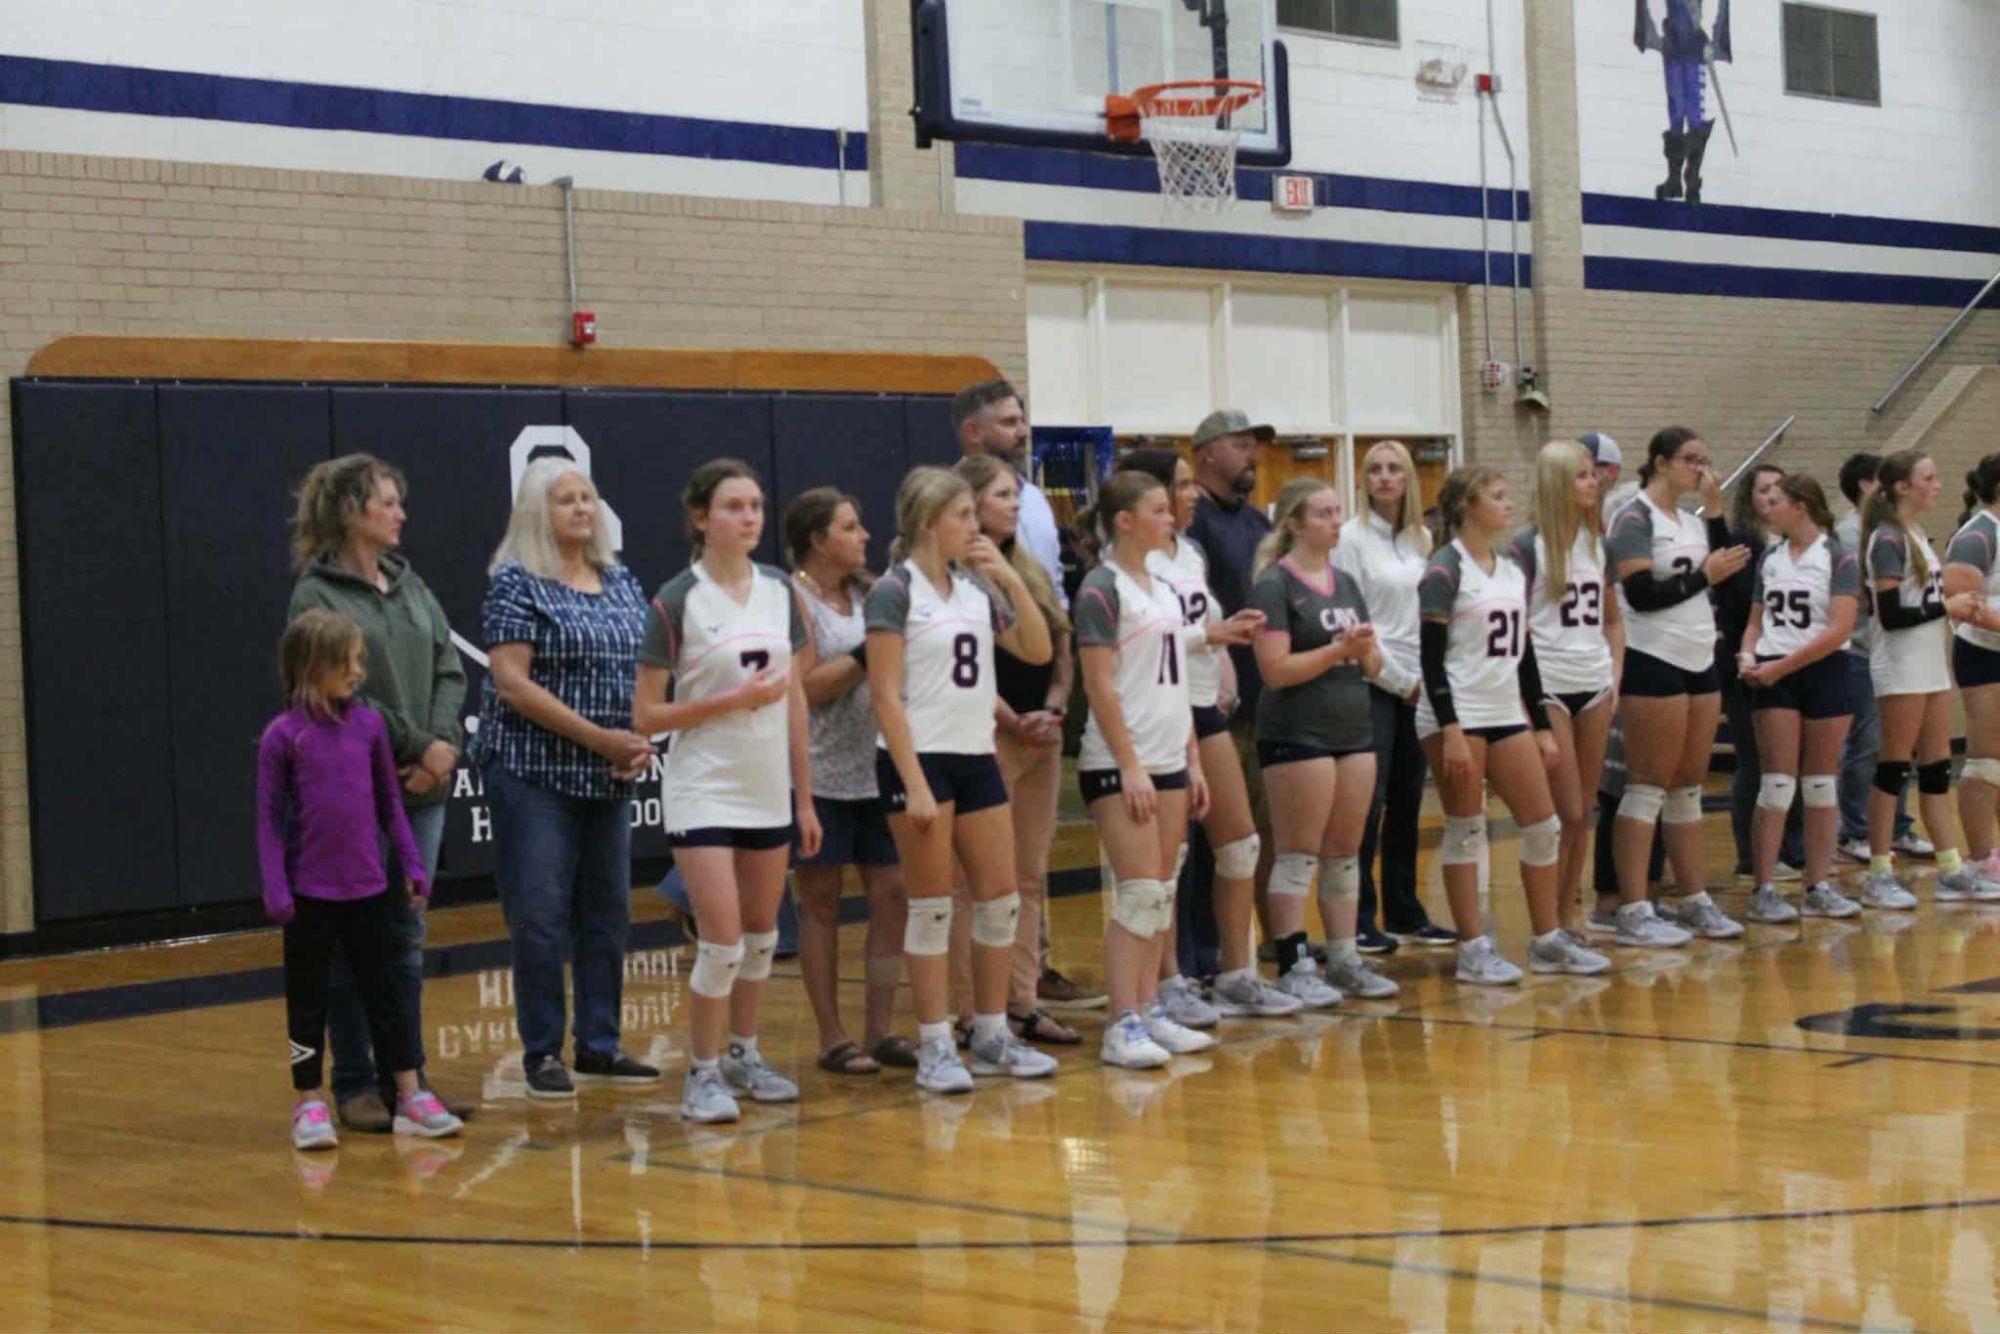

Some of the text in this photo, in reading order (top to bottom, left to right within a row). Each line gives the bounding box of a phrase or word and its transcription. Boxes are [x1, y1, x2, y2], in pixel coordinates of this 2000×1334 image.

[1560, 582, 1600, 627] 23
[1766, 590, 1811, 629] 25
[1487, 609, 1519, 657] 21
[953, 633, 979, 688] 8
[1158, 632, 1178, 685] 11
